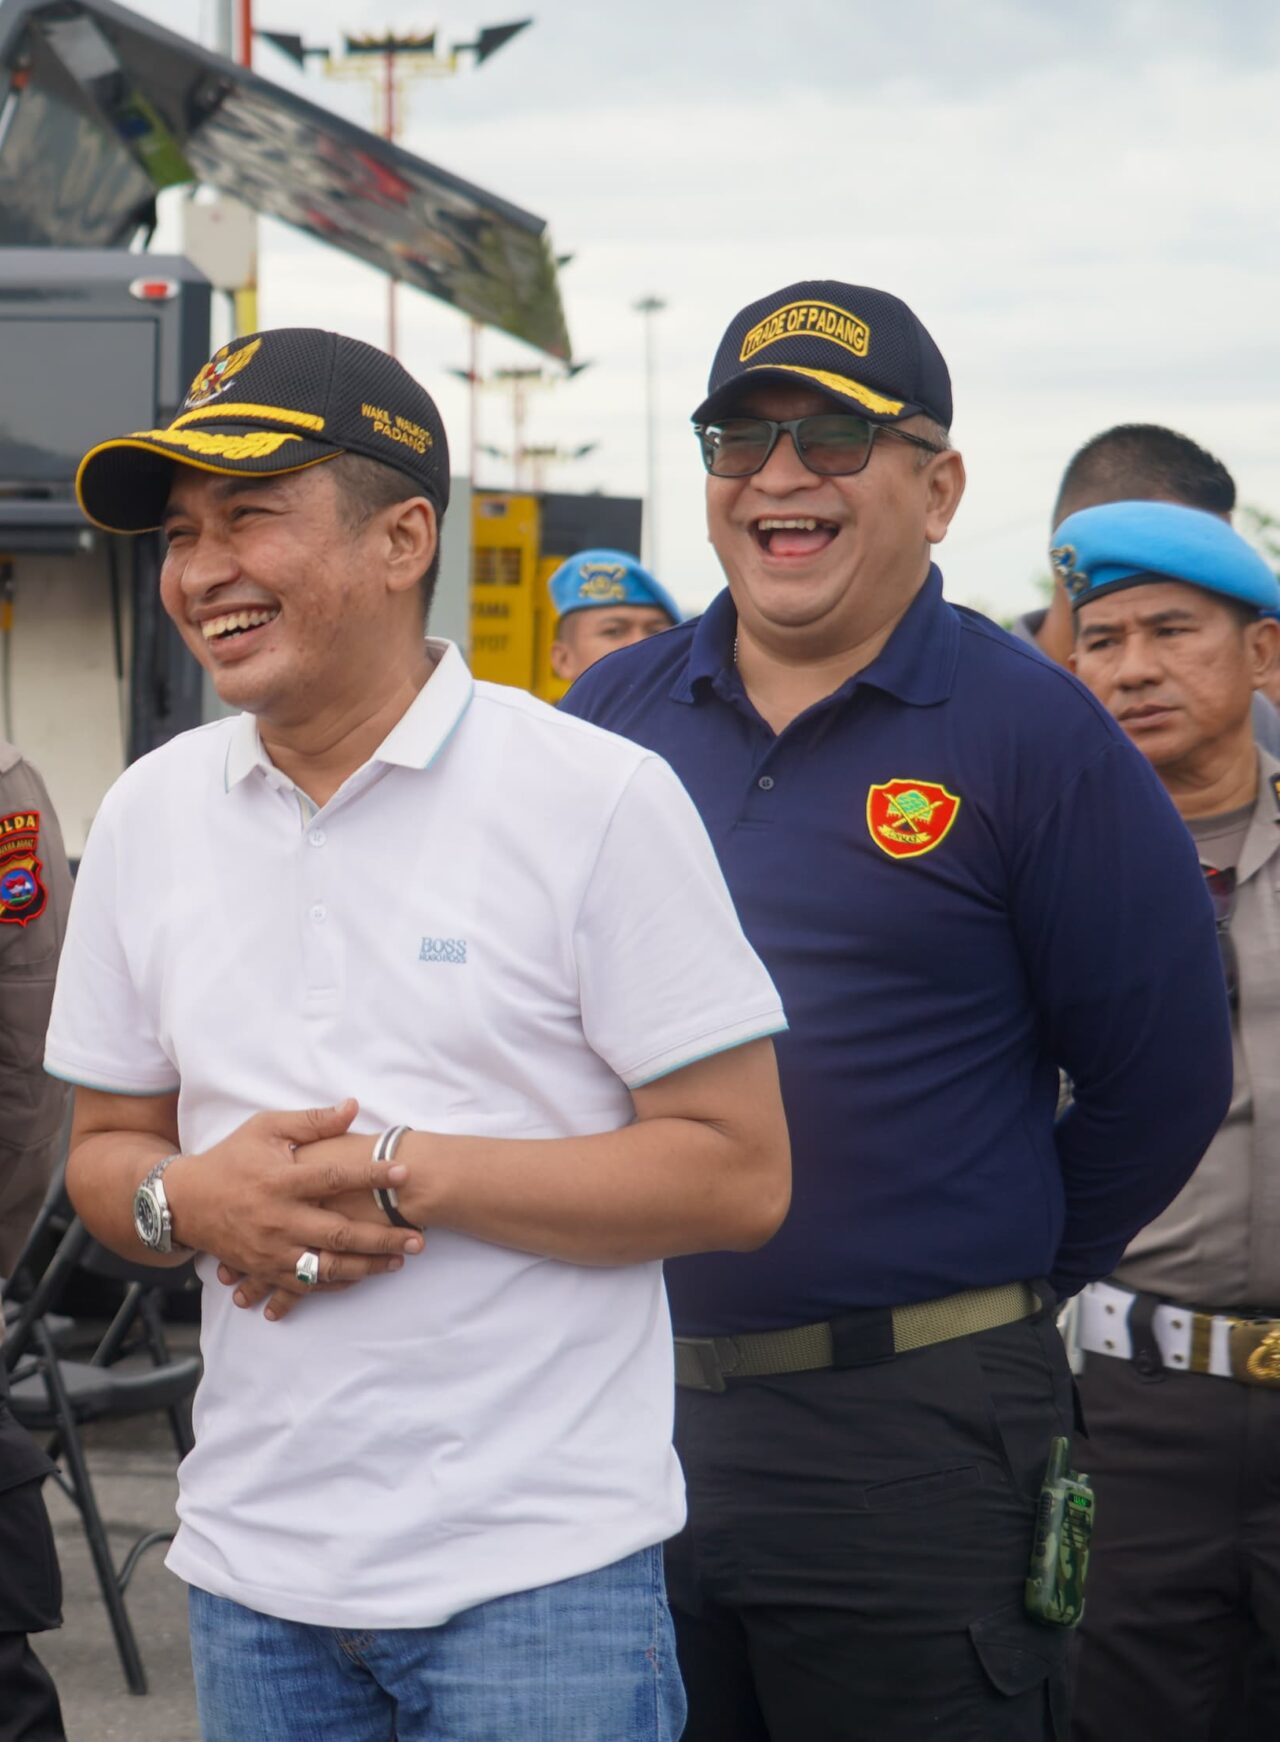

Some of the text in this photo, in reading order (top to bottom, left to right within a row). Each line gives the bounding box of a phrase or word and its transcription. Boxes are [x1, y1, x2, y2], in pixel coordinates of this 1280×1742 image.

[746, 308, 866, 353] TRADE OF PADANG
[373, 420, 426, 454] PADANG
[421, 936, 466, 956] BOSS
